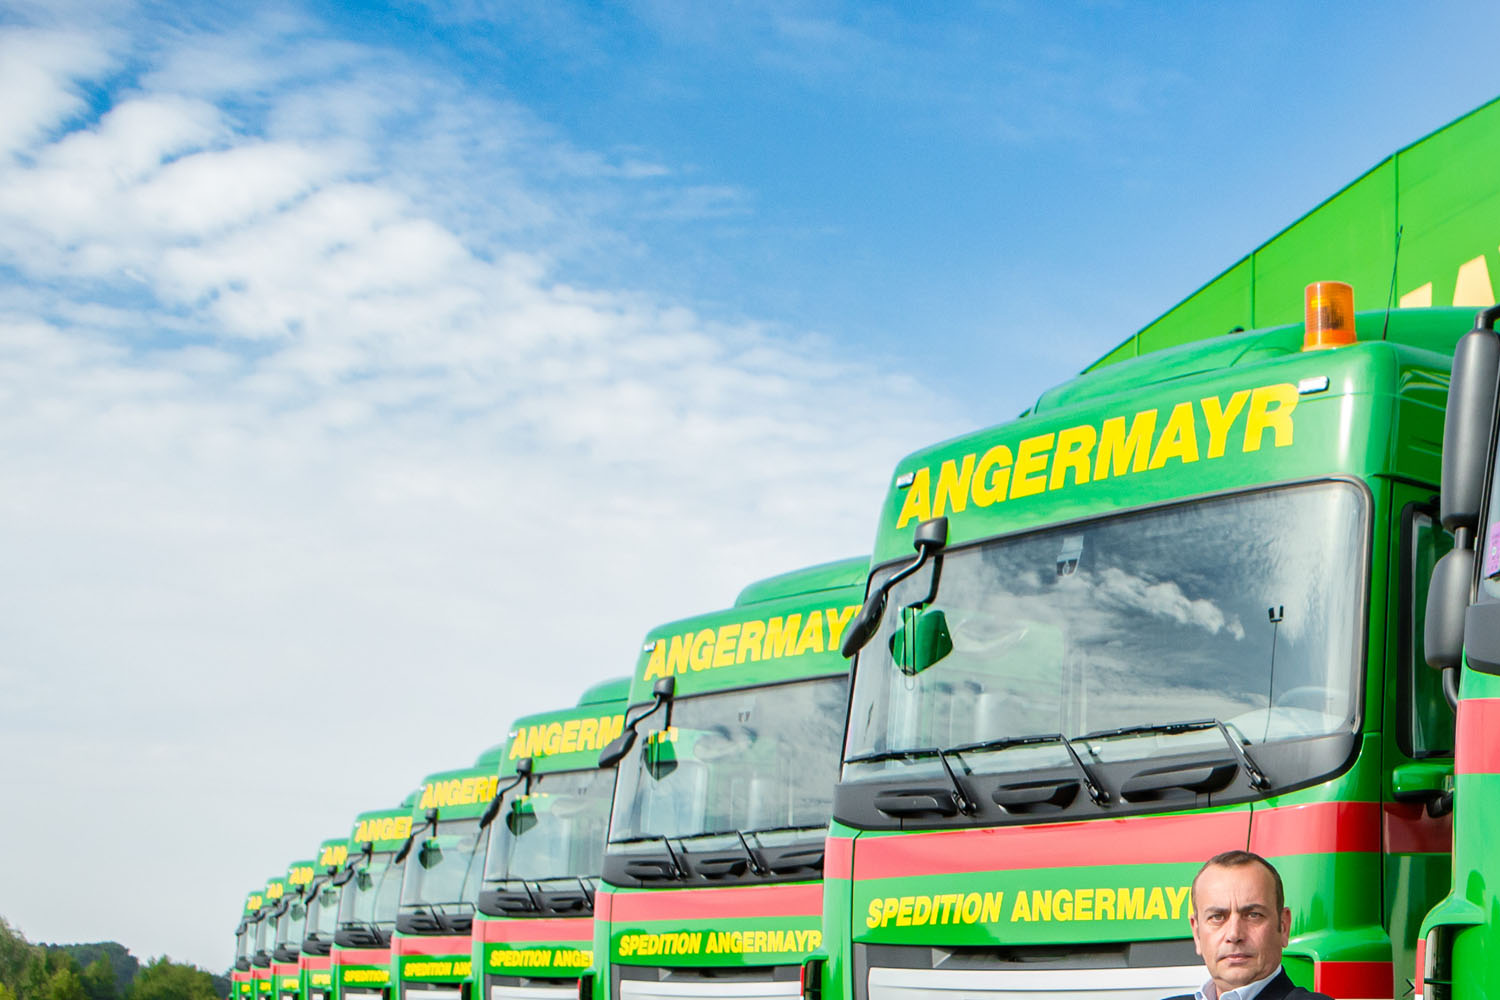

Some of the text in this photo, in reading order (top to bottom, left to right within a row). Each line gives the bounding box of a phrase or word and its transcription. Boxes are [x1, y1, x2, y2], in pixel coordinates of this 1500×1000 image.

[896, 382, 1300, 530] ANGERMAYR
[643, 604, 863, 681] ANGERMAY
[866, 886, 1194, 930] SPEDITION ANGERMAY
[489, 950, 553, 967] SPEDITION
[618, 929, 823, 957] SPEDITION ANGERMAYR
